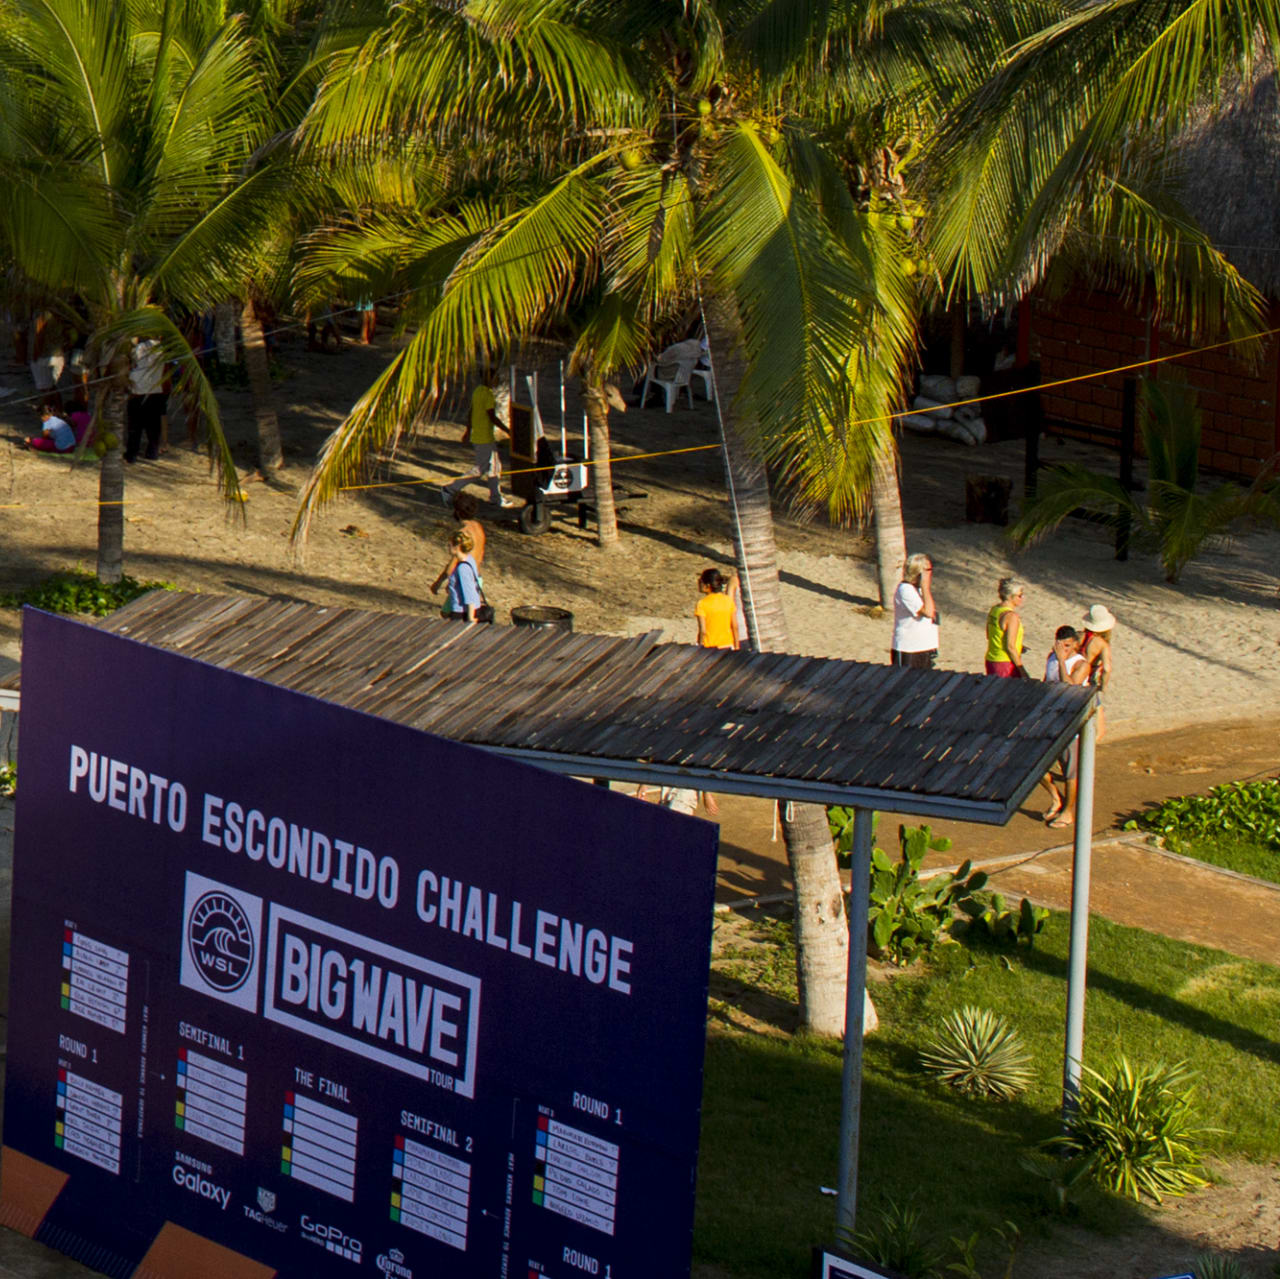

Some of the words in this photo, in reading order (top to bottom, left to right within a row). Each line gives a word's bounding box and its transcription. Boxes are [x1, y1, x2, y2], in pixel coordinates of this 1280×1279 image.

[68, 743, 188, 833] PUERTO
[202, 793, 400, 910] ESCONDIDO
[416, 870, 635, 996] CHALLENGE
[200, 950, 240, 978] WSL
[59, 1034, 88, 1058] ROUND
[91, 1048, 98, 1064] 1
[178, 1021, 232, 1056] SEMIFINAL
[237, 1045, 245, 1061] 1
[294, 1067, 314, 1089] THE
[318, 1077, 352, 1103] FINAL
[429, 1069, 454, 1091] TOUR
[572, 1091, 609, 1119] ROUND
[614, 1108, 623, 1125] 1
[400, 1110, 460, 1147] SEMIFINAL
[465, 1136, 473, 1152] 2
[175, 1150, 213, 1175] SAMSUNG
[172, 1165, 232, 1210] Galaxy
[300, 1214, 364, 1253] GoPro
[376, 1254, 413, 1279] Corona
[562, 1246, 599, 1275] ROUND
